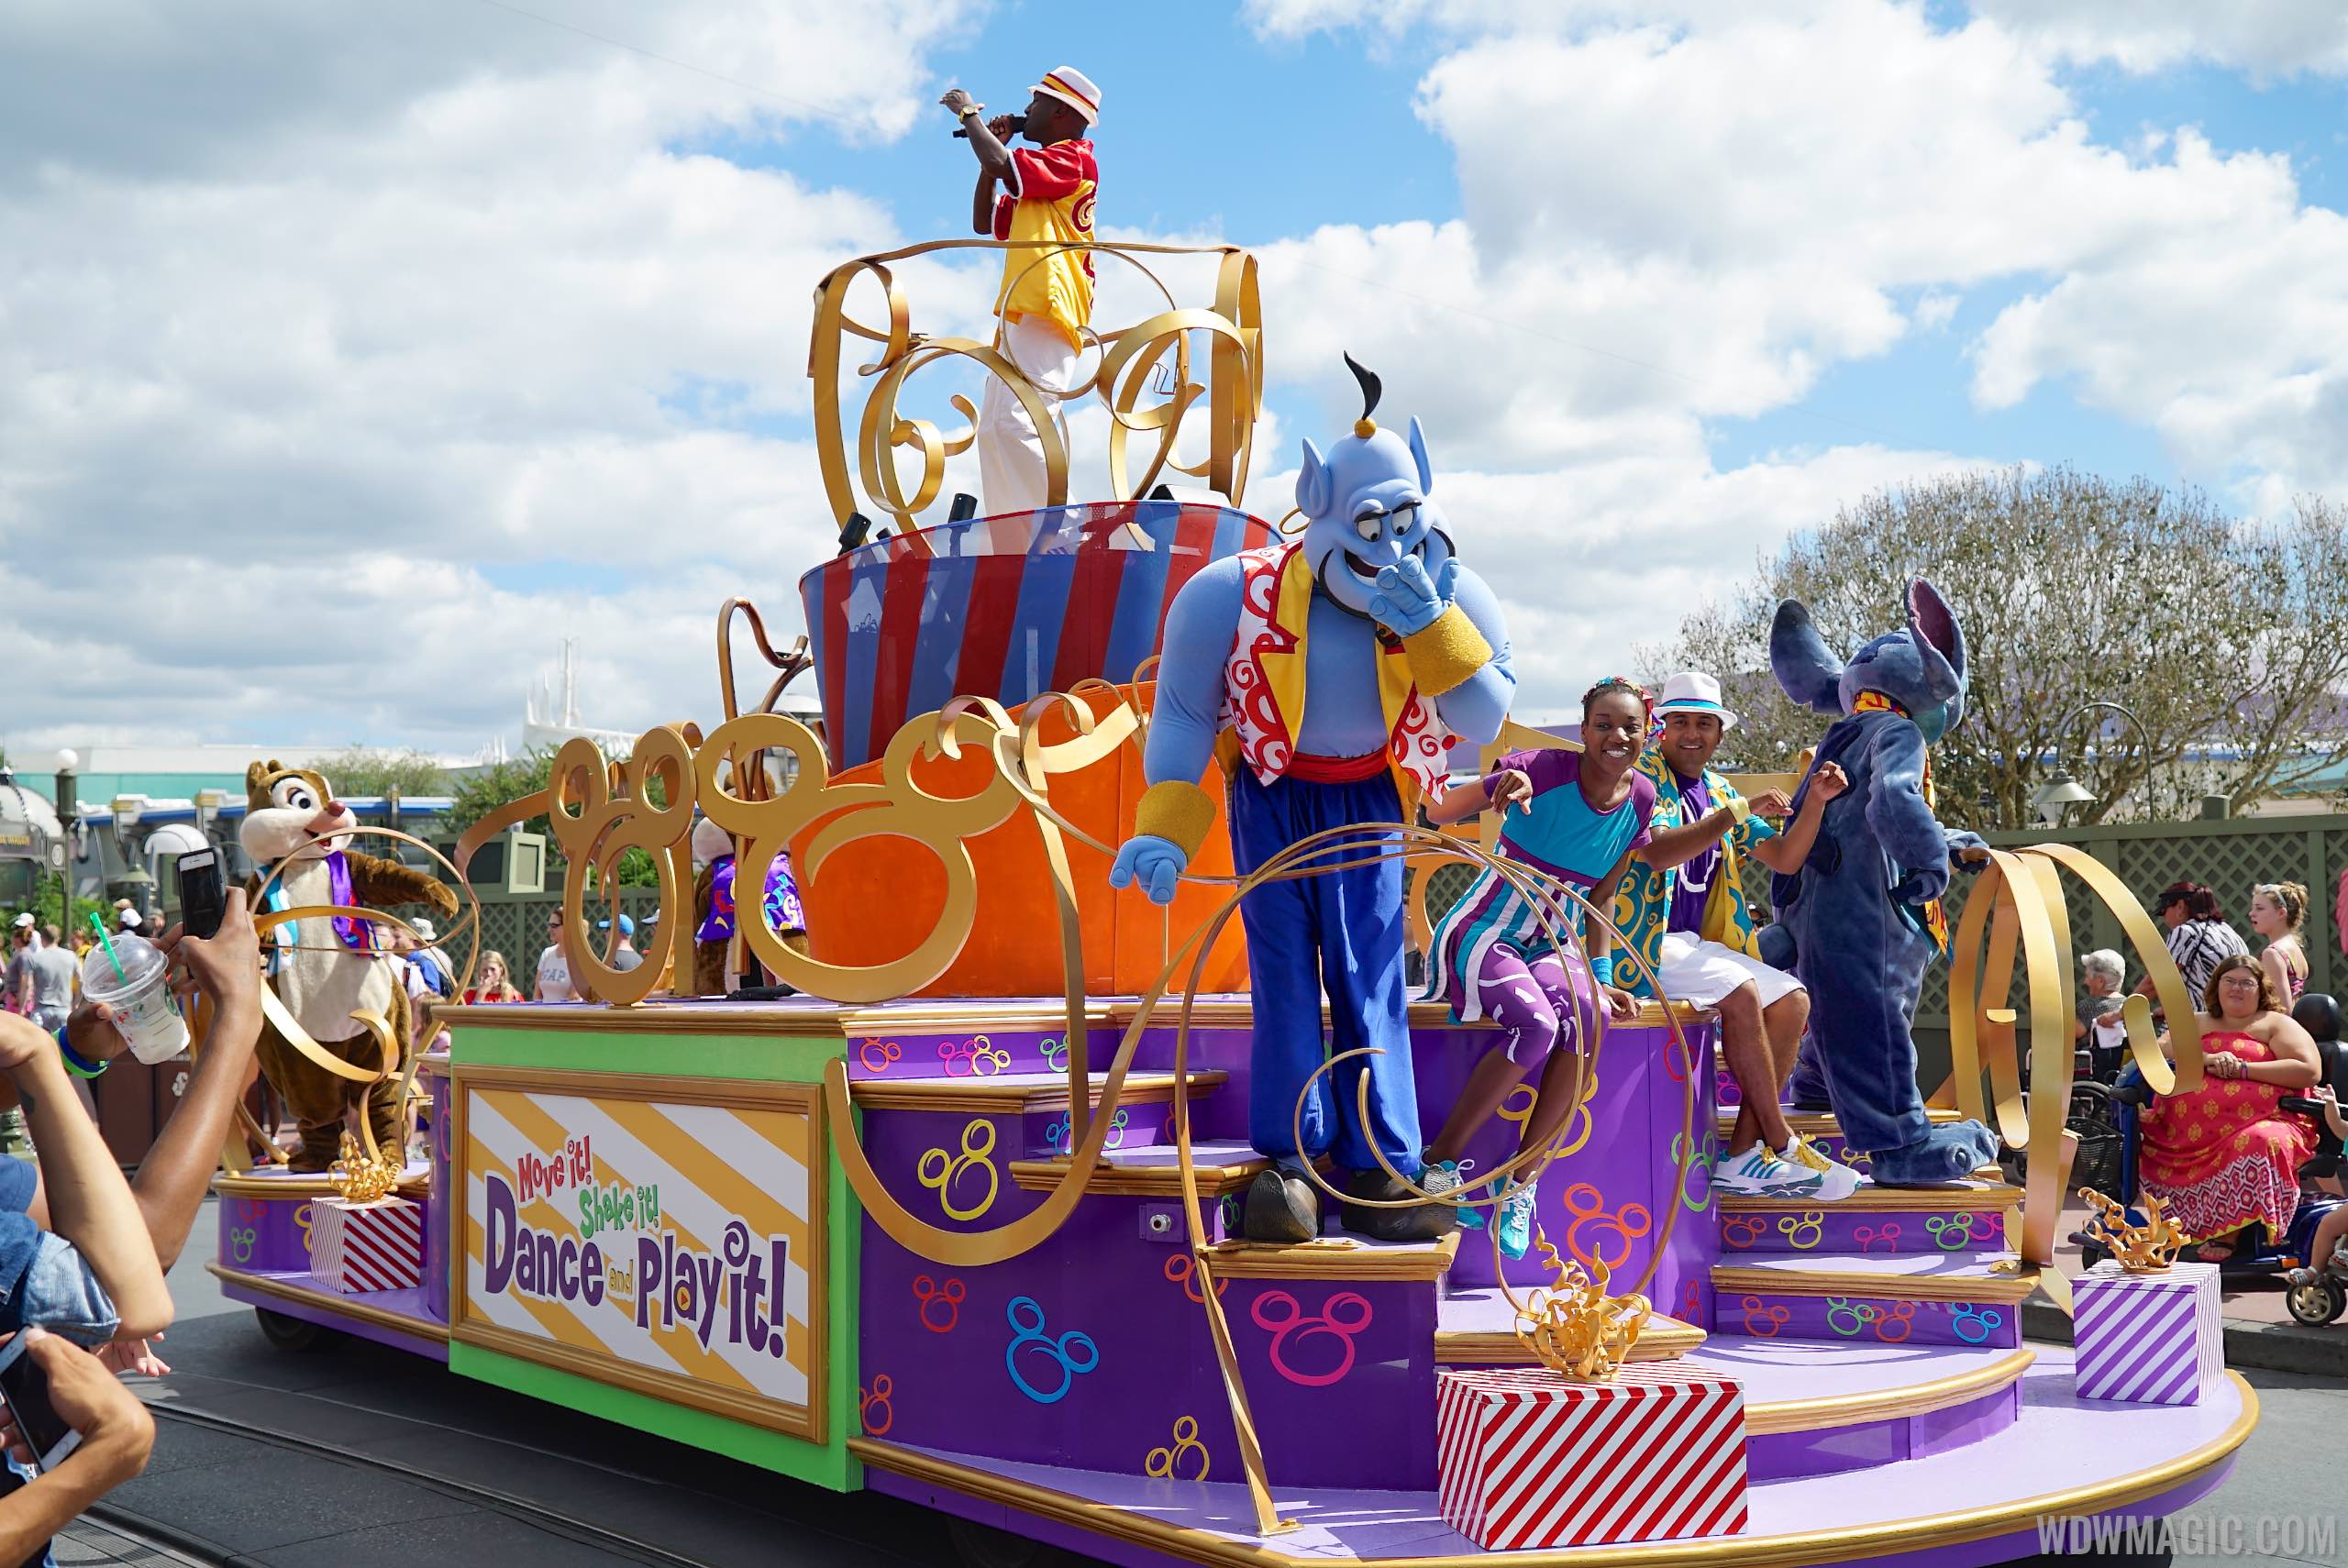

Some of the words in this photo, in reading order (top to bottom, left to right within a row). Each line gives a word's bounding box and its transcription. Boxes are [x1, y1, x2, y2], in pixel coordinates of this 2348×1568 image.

[517, 1153, 564, 1202] Move
[569, 1135, 593, 1189] it!
[579, 1188, 634, 1239] Shake
[637, 1184, 659, 1229] it!
[485, 1176, 604, 1307] Dance
[609, 1259, 633, 1294] and
[637, 1235, 723, 1349] Play
[723, 1221, 787, 1359] it!
